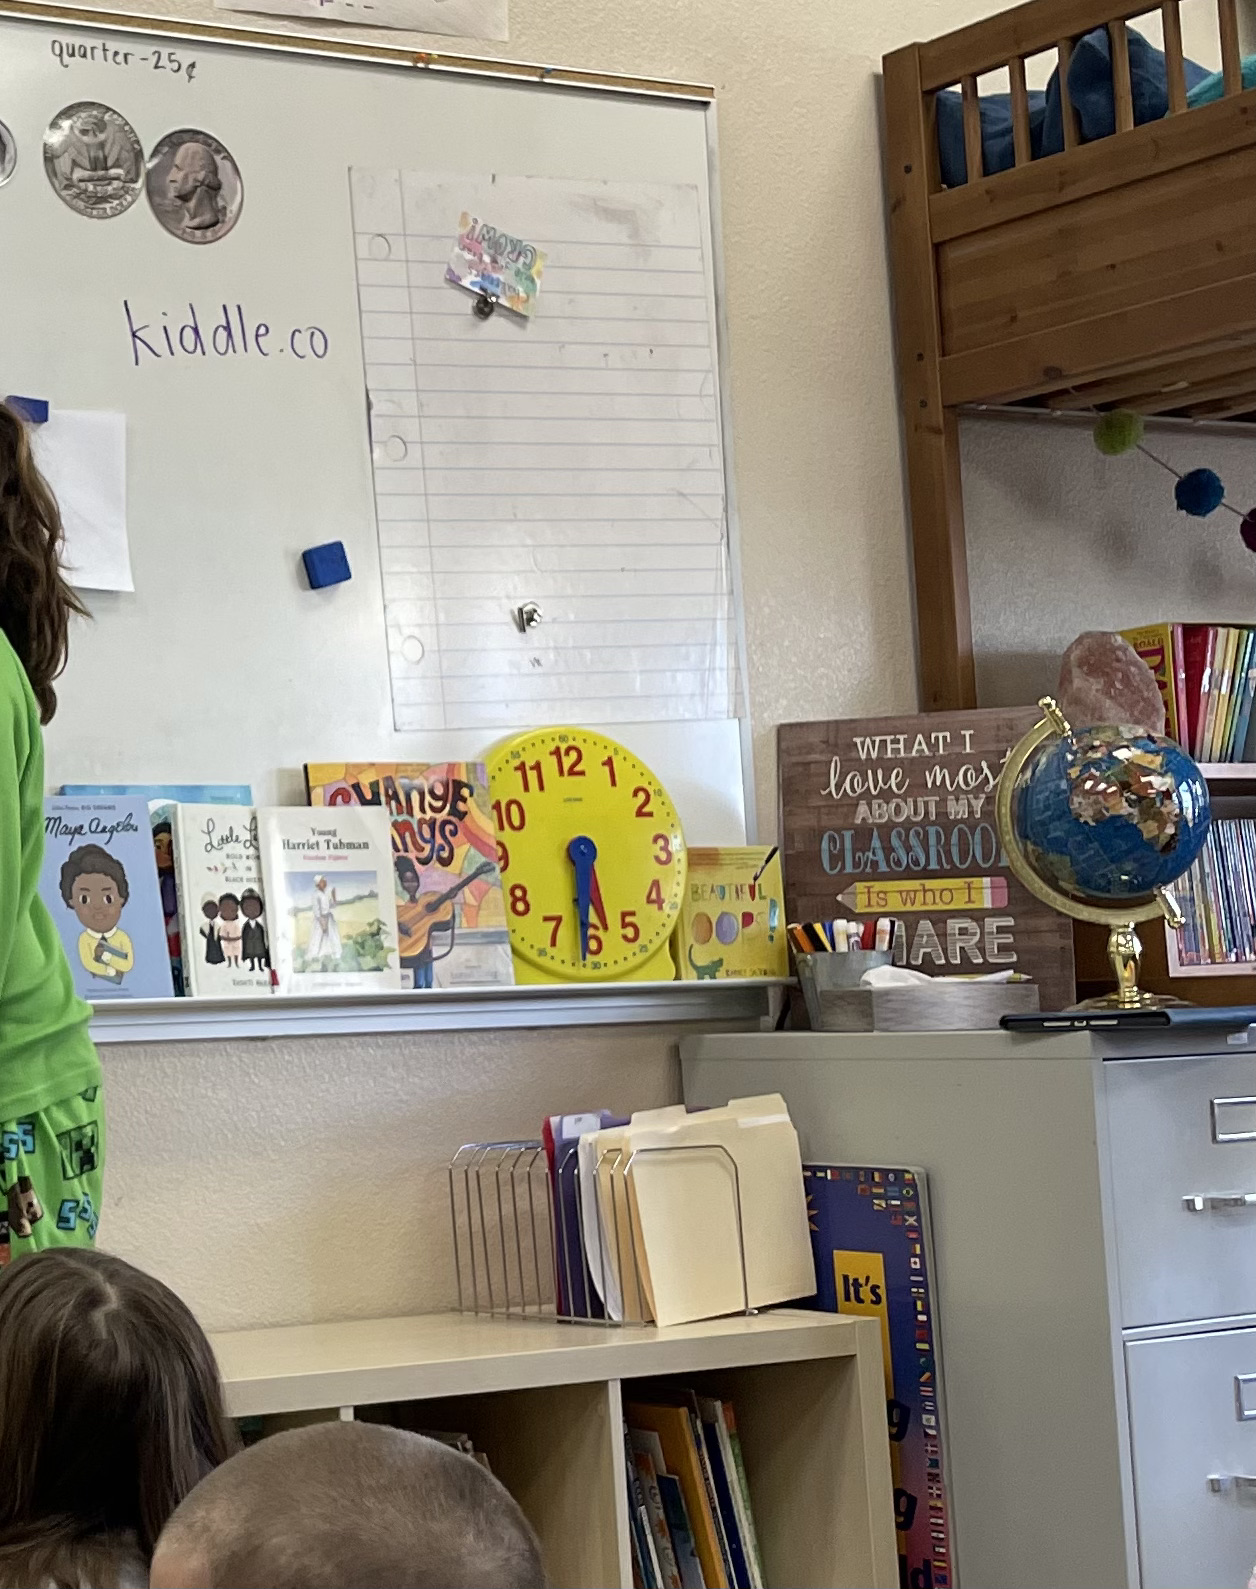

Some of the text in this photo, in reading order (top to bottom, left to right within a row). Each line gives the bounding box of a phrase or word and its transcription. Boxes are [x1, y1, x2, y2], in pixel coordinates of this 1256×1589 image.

[123, 300, 329, 366] kiddle.co
[549, 745, 586, 777] 12
[853, 730, 975, 761] WHAT I
[513, 760, 545, 793] 11
[601, 755, 617, 787] 1
[820, 756, 910, 800] love
[491, 798, 526, 832] 10
[632, 786, 654, 818] 2
[854, 794, 986, 824] ABOUT MY
[45, 815, 87, 846] Maya
[282, 838, 370, 850] Harriet Tubman
[310, 826, 337, 838] Young
[652, 833, 672, 866] 3
[820, 823, 1009, 875] CLASSROO
[509, 883, 530, 917] 8
[646, 879, 665, 911] 4
[690, 882, 768, 902] BEAUTIFUL
[864, 882, 975, 908] Is who I
[542, 915, 563, 948] 7
[586, 922, 603, 956] 6
[620, 910, 640, 943] 5
[893, 917, 1018, 966] ARE
[841, 1273, 882, 1306] It's
